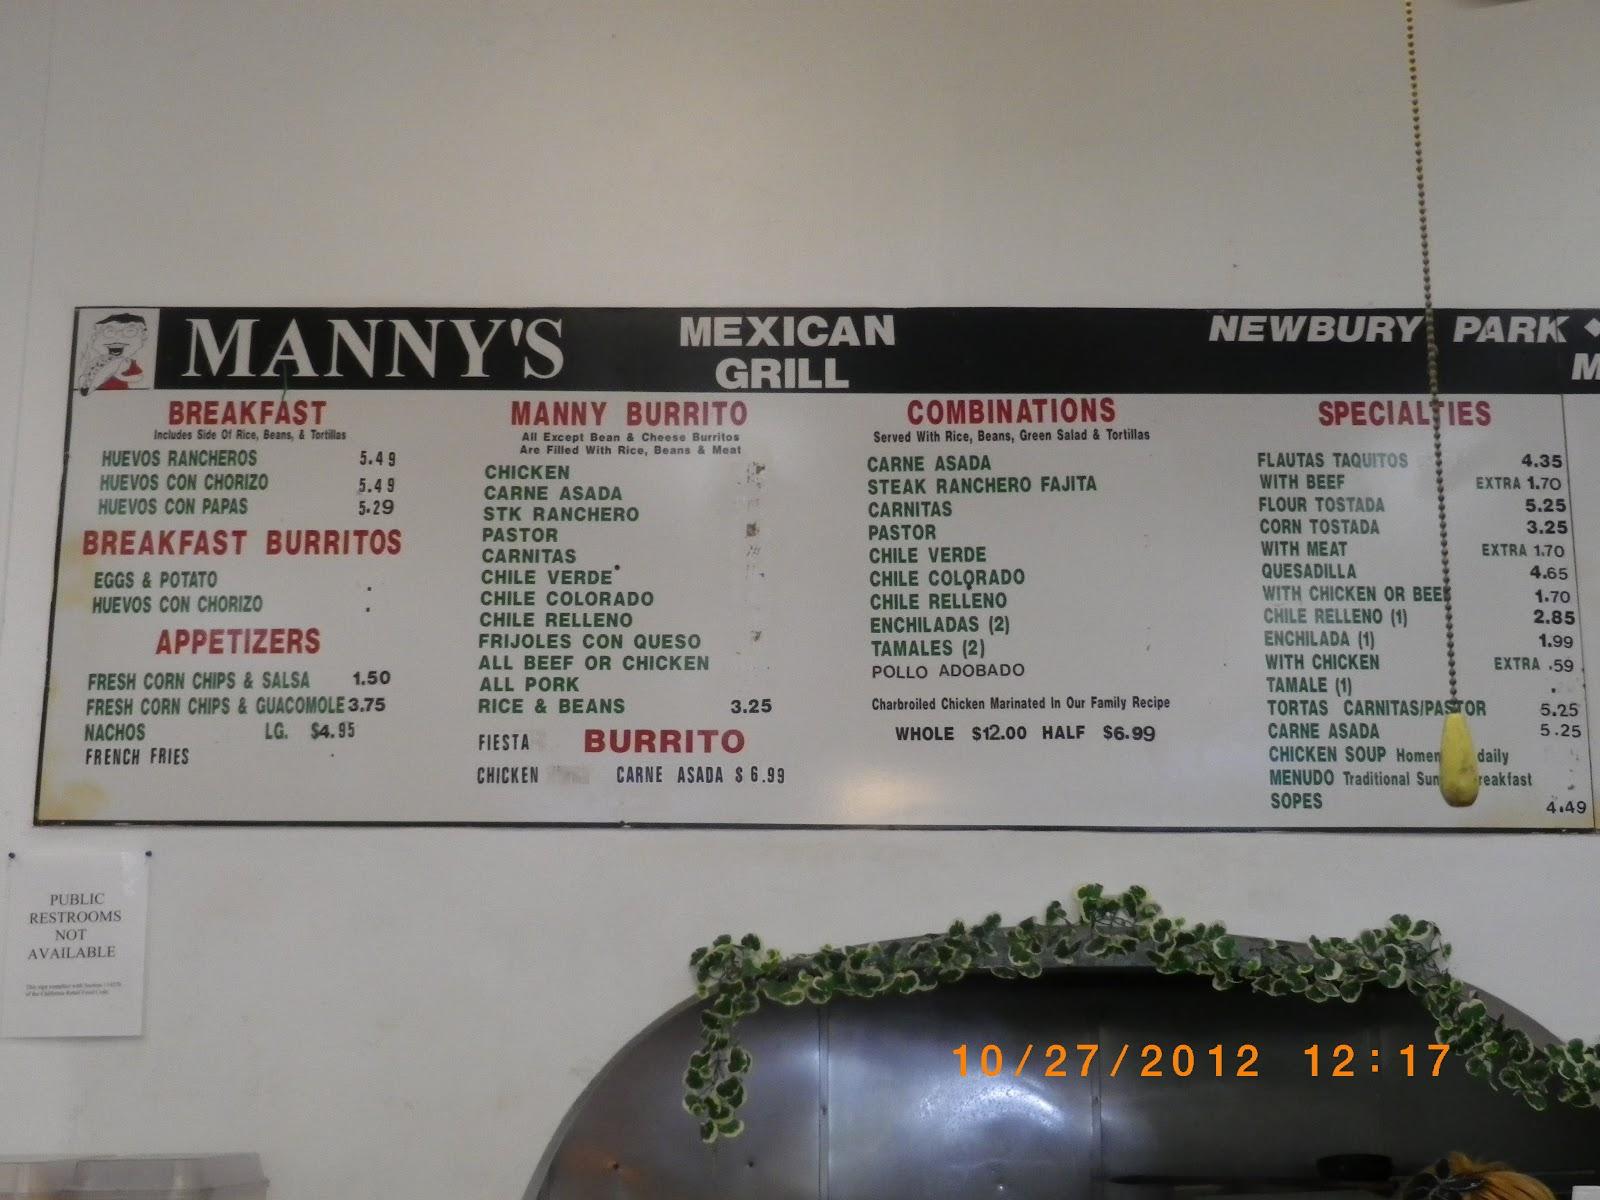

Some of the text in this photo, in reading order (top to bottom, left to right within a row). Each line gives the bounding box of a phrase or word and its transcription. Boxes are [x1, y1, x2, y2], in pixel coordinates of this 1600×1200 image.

[680, 315, 895, 346] MEXICAN
[1209, 315, 1569, 343] NEWBURY PARK
[182, 319, 563, 379] MANNY'S
[716, 358, 849, 389] GRILL
[169, 400, 326, 425] BREAKFAST
[512, 401, 747, 426] MANNY BURRITO
[907, 398, 1116, 425] COMBINATIONS
[154, 430, 192, 439] Includes
[198, 430, 216, 439] Side
[222, 429, 232, 439] Of
[311, 429, 346, 440] Tortillas
[522, 432, 739, 443] All Except Bean Cheese Burritos
[874, 431, 911, 443] Served
[917, 431, 940, 442] With
[978, 430, 1014, 444] Beans,
[1020, 430, 1051, 441] Green
[1057, 429, 1087, 440] Salad
[1106, 429, 1150, 440] Tortillas
[520, 445, 540, 454] Are
[547, 446, 578, 454] Filled
[586, 446, 611, 454] With
[654, 446, 690, 454] Beans
[713, 446, 741, 454] Meat
[102, 450, 395, 467] HUEVOS RANCHEROS 5.49
[867, 455, 991, 472] CARNE ASADA
[1258, 453, 1562, 468] FLAUTAS TAQUITOS 4.35
[485, 465, 569, 479] CHICKEN
[100, 473, 394, 493] HUEVOS CON CHORIZO 5.49
[868, 476, 1097, 495] STEAK RANCHERO FAJITA
[1260, 474, 1561, 490] WITH BEEF EXTRA 1.70
[99, 498, 394, 515] HUEVOS CON PAPAS 5.29
[868, 501, 952, 518] CARNITAS
[1259, 497, 1566, 512] FLOUR TOSTADA 5.25
[484, 507, 639, 521] STK RANCHERO
[483, 528, 557, 542] PASTOR
[869, 524, 936, 540] PASTOR
[1260, 519, 1568, 534] CORN TOSTADA 3.25
[83, 529, 401, 555] BREAKFAST BURRITOS
[1261, 541, 1564, 557] WITH MEAT EXTRA 1.70
[482, 549, 576, 563] CARNITAS
[94, 571, 217, 588] EGGS POTATO
[870, 569, 1025, 587] CHILE COLORADO
[1262, 563, 1568, 580] QUESADILLA 4.65
[481, 591, 653, 606] CHILE COLORADO
[871, 616, 1009, 635] ENCHILADAS (2)
[156, 628, 320, 654] APPETIZERS
[479, 634, 700, 649] FRIJOLES CON QUESO
[871, 639, 984, 659] TAMALES (2)
[1264, 631, 1573, 650] ENCHILADA (1) 1.99
[1265, 654, 1304, 669] WITH
[1313, 654, 1379, 670] CHICKEN
[1494, 657, 1540, 670] EXTRA
[873, 664, 1024, 678] POLLO ADOBADO
[88, 671, 391, 690] FRESH CORN CHIPS SALSA 1.50
[86, 696, 385, 715] FRESH CORN CHIPS GUACOMOLE 3.75
[479, 698, 772, 713] RICE BEANS 3.25
[872, 696, 1170, 710] Charbroiled Chicken Marinated In Our Family Recipe
[1267, 700, 1328, 716] TORTAS
[1541, 703, 1578, 717] 5.25
[85, 722, 354, 741] NACHOS LG. $4.95
[896, 724, 1155, 742] WHOLE $12.00 HALF $6.99
[479, 729, 744, 753] FIESTA BURRITO
[86, 748, 189, 765] FRENCH FRIES
[1269, 746, 1508, 765] CHICKEN SOUP daily
[477, 766, 723, 784] CHICKEN CARNE ASADA
[1270, 769, 1409, 785] MENUDO Traditional
[1271, 793, 1586, 814] SOPES 4.49
[51, 893, 104, 905] PUBLIC
[30, 911, 121, 924] RESTROOMS
[56, 929, 86, 940] NOT
[28, 946, 115, 959] AVAILABLE
